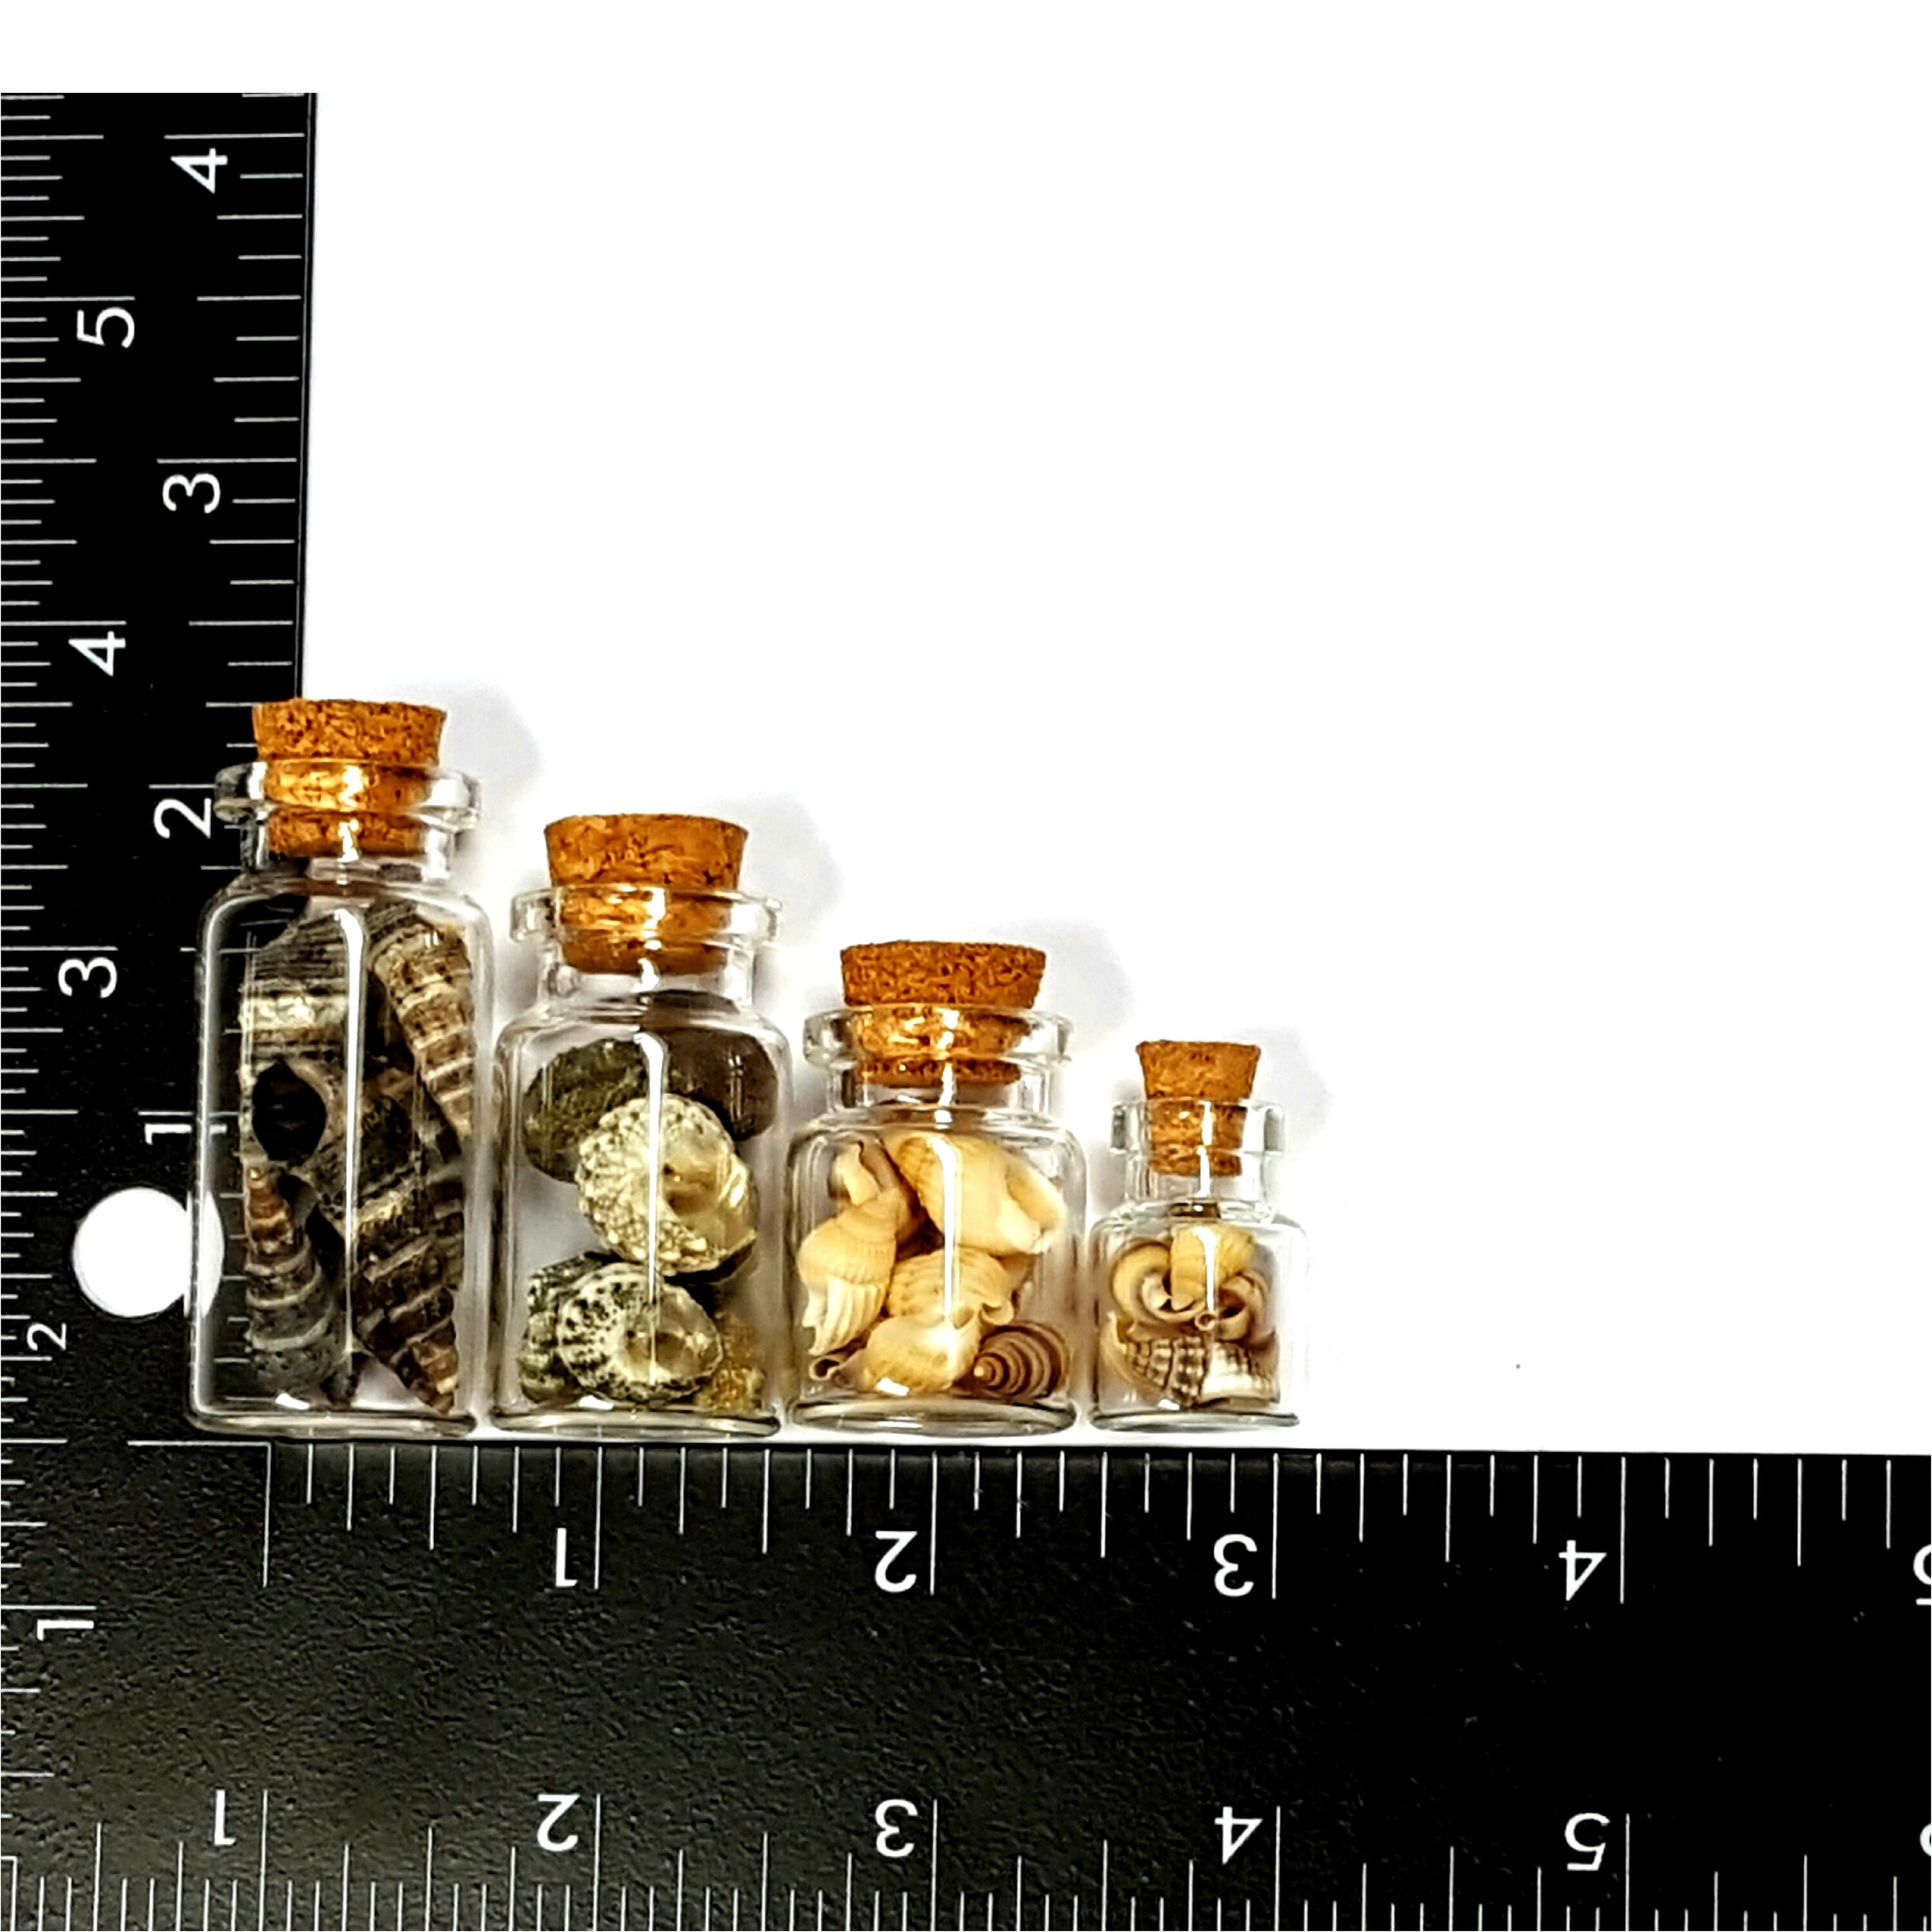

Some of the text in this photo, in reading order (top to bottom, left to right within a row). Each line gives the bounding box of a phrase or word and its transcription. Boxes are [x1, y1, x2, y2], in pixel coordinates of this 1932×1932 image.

[171, 149, 227, 193] 4
[77, 307, 135, 348] 5
[162, 473, 221, 514] 3
[68, 630, 126, 676] 4
[153, 798, 212, 838] 2
[58, 956, 117, 999] 3
[26, 1323, 66, 1351] 2
[555, 1528, 578, 1588] 1
[874, 1530, 918, 1593] 2
[1213, 1533, 1258, 1597] 3
[1558, 1540, 1607, 1601] 4
[37, 1619, 95, 1642] 1
[214, 1789, 236, 1846] 1
[536, 1794, 580, 1852] 2
[875, 1799, 918, 1858] 3
[1215, 1806, 1262, 1864] 4
[1564, 1812, 1610, 1871] 5
